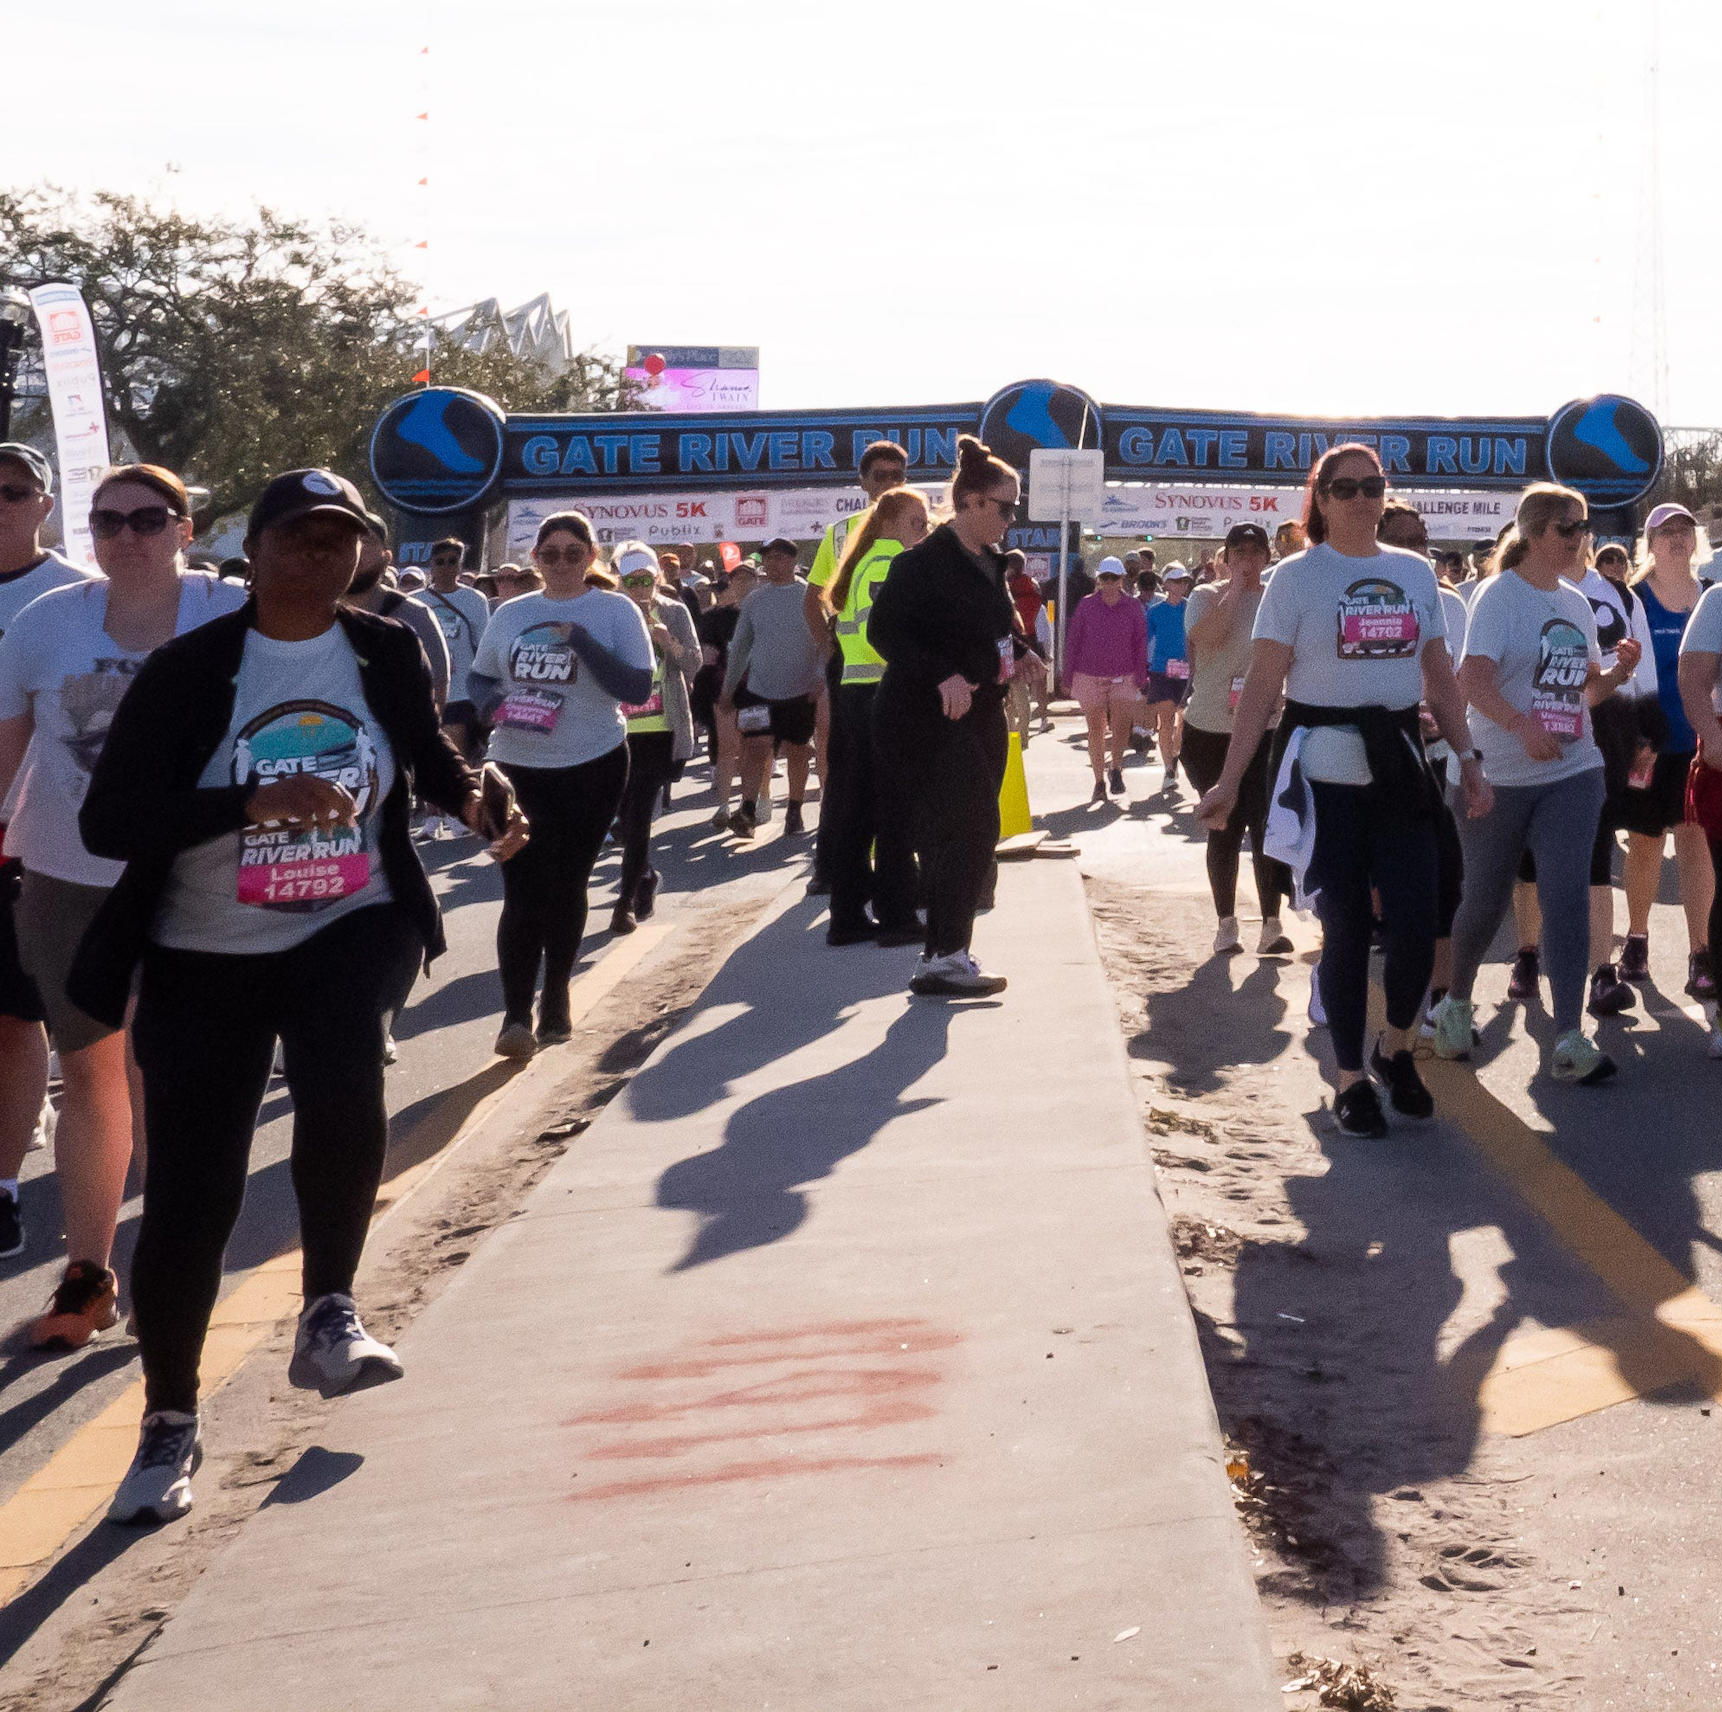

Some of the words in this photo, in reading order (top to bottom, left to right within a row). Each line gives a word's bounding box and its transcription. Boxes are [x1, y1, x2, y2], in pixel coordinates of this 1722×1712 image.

[522, 434, 661, 475] GATE
[679, 429, 836, 472] RIVER
[1119, 426, 1249, 468] GATE
[1426, 435, 1526, 475] RUN
[574, 501, 669, 519] SYNOVUS
[676, 501, 708, 518] 5K
[1155, 491, 1243, 510] SYNOVUS
[1249, 495, 1279, 513] 5K
[1473, 501, 1500, 515] MILE
[650, 524, 701, 537] Publix
[516, 650, 567, 664] RIVER
[514, 662, 572, 681] RUN
[256, 755, 317, 775] GATE
[243, 831, 290, 847] GATE
[240, 842, 314, 866] RIVER
[313, 837, 362, 859] RUN
[270, 864, 340, 882] Louise
[264, 877, 345, 900] 14792
